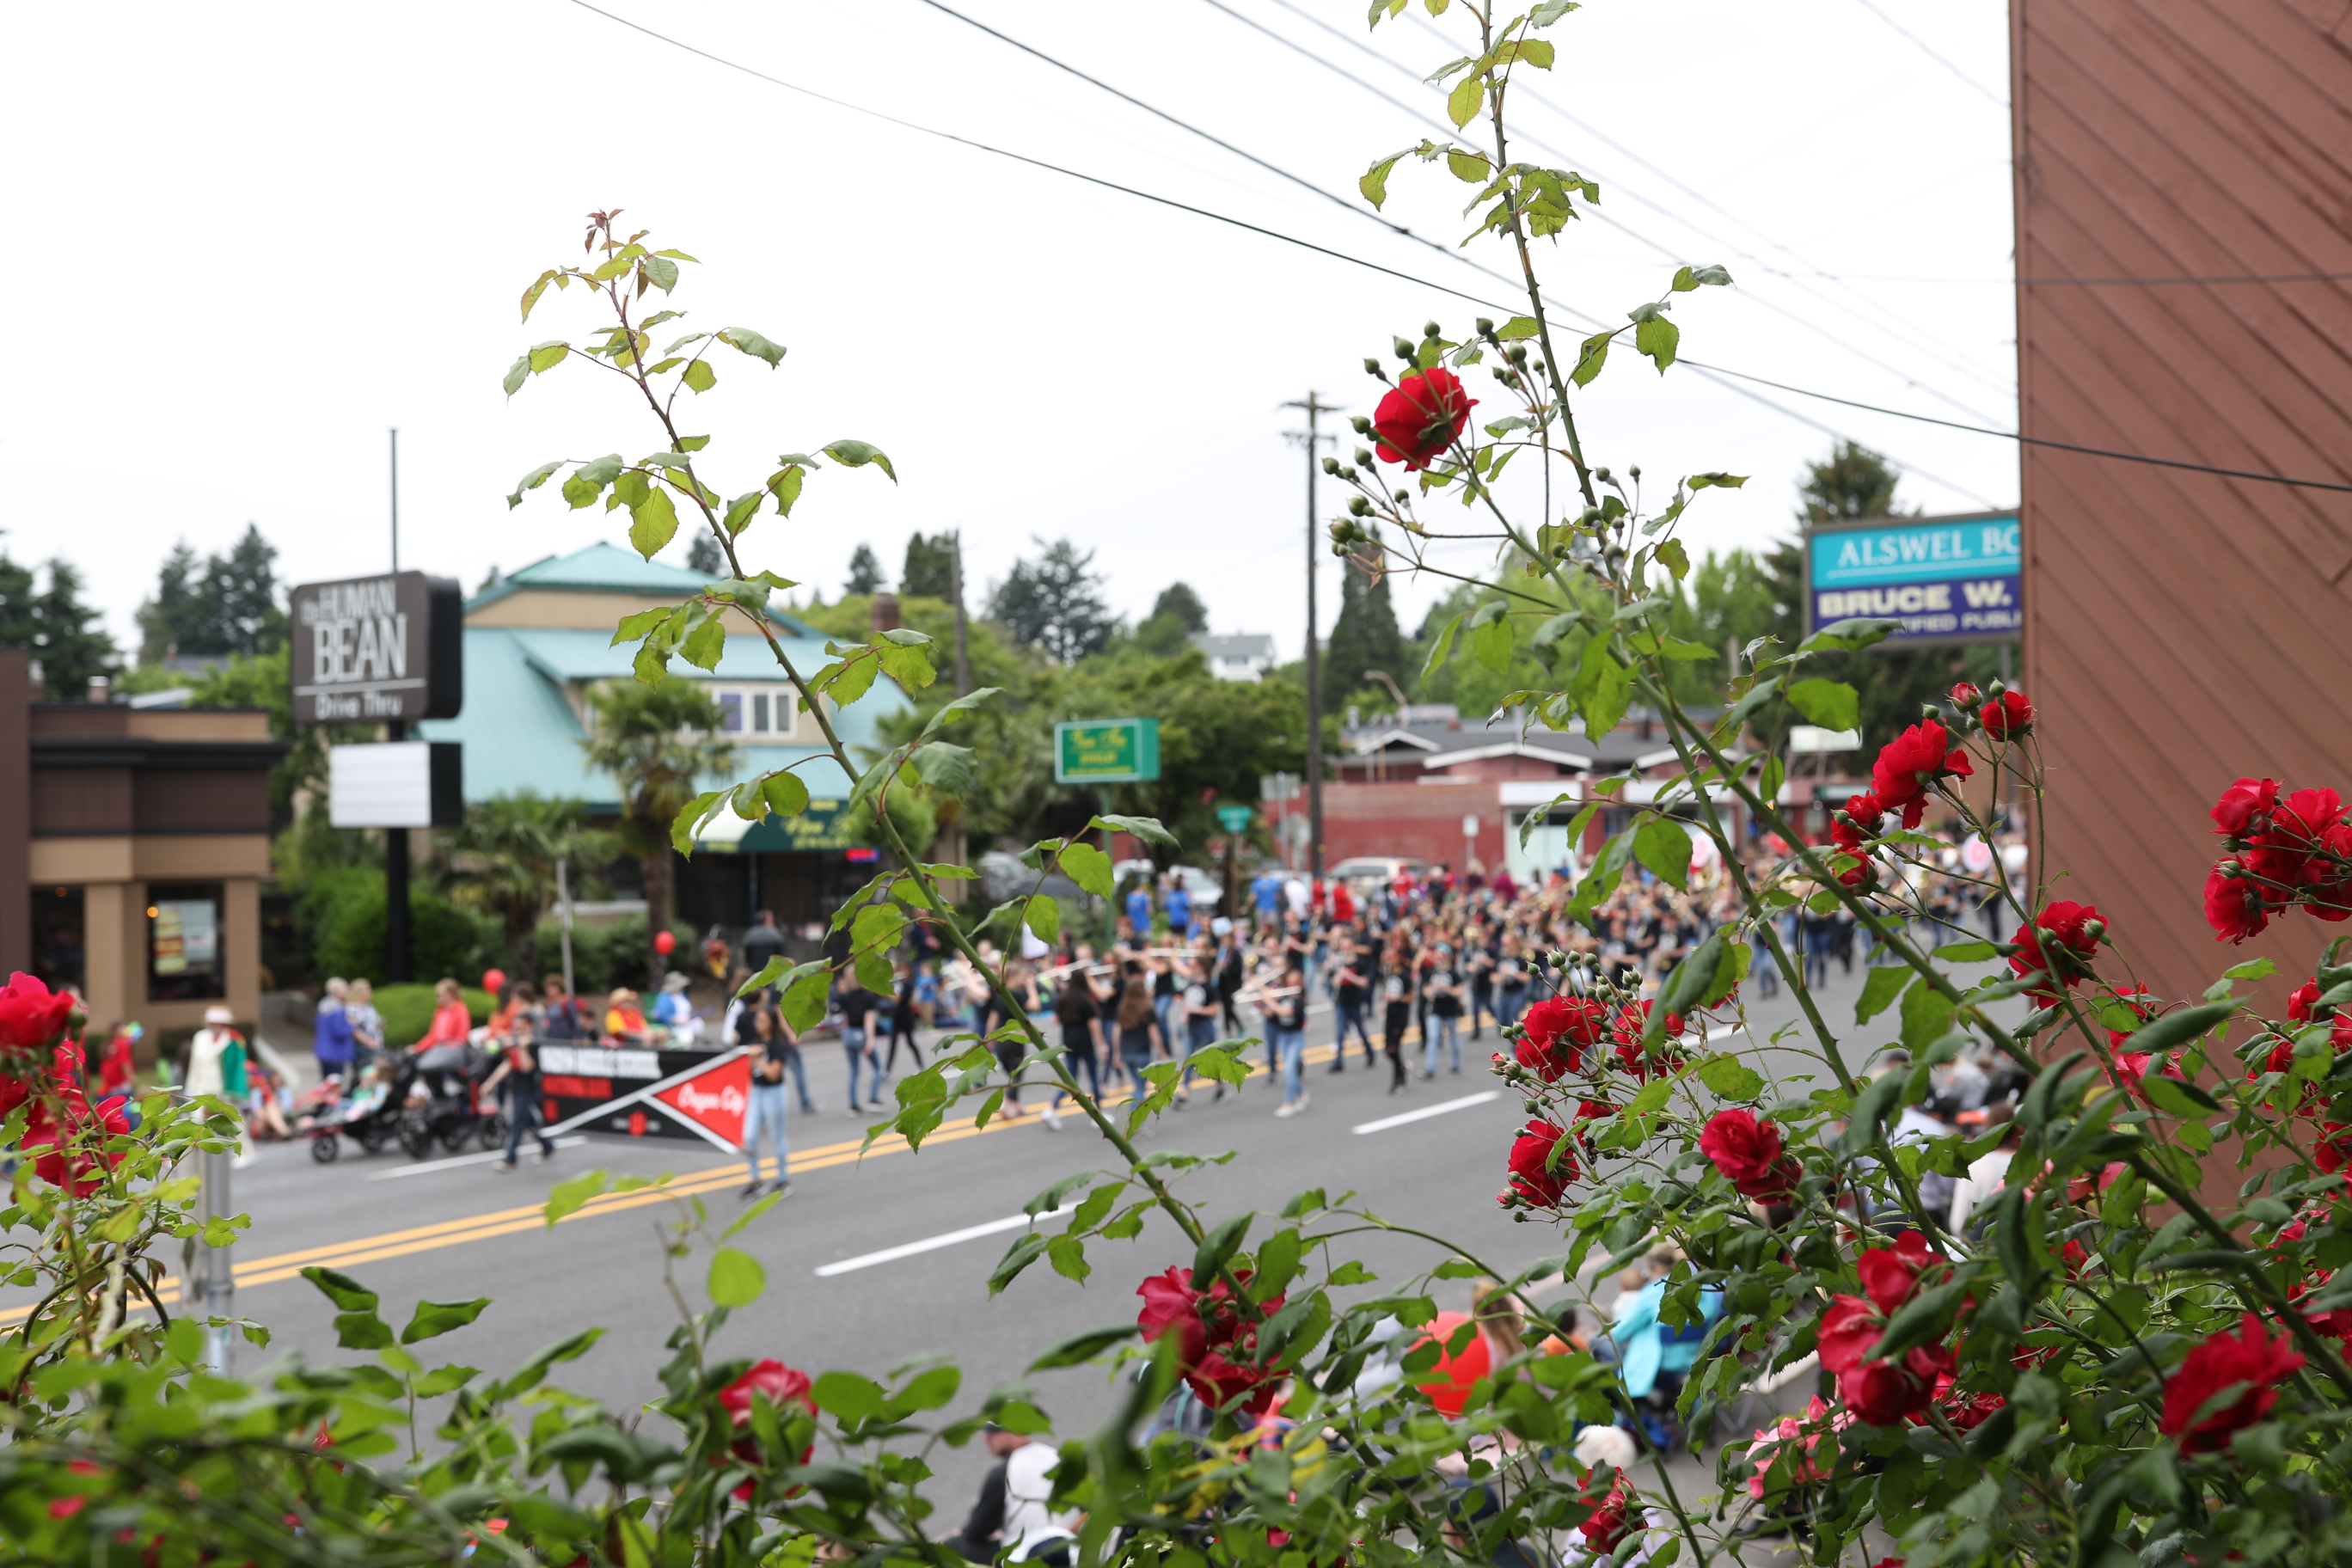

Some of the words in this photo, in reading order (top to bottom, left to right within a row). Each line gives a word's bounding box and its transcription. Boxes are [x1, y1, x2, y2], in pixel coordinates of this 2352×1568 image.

[1838, 530, 1972, 568] ALSWEL
[318, 579, 396, 621] HUMAN
[1818, 584, 1951, 618] BRUCE
[1963, 579, 2012, 608] W.
[313, 613, 408, 685] BEAN
[315, 691, 360, 720] Drive
[363, 689, 402, 717] Thru
[677, 1082, 720, 1115] Oregon
[720, 1085, 746, 1118] City
